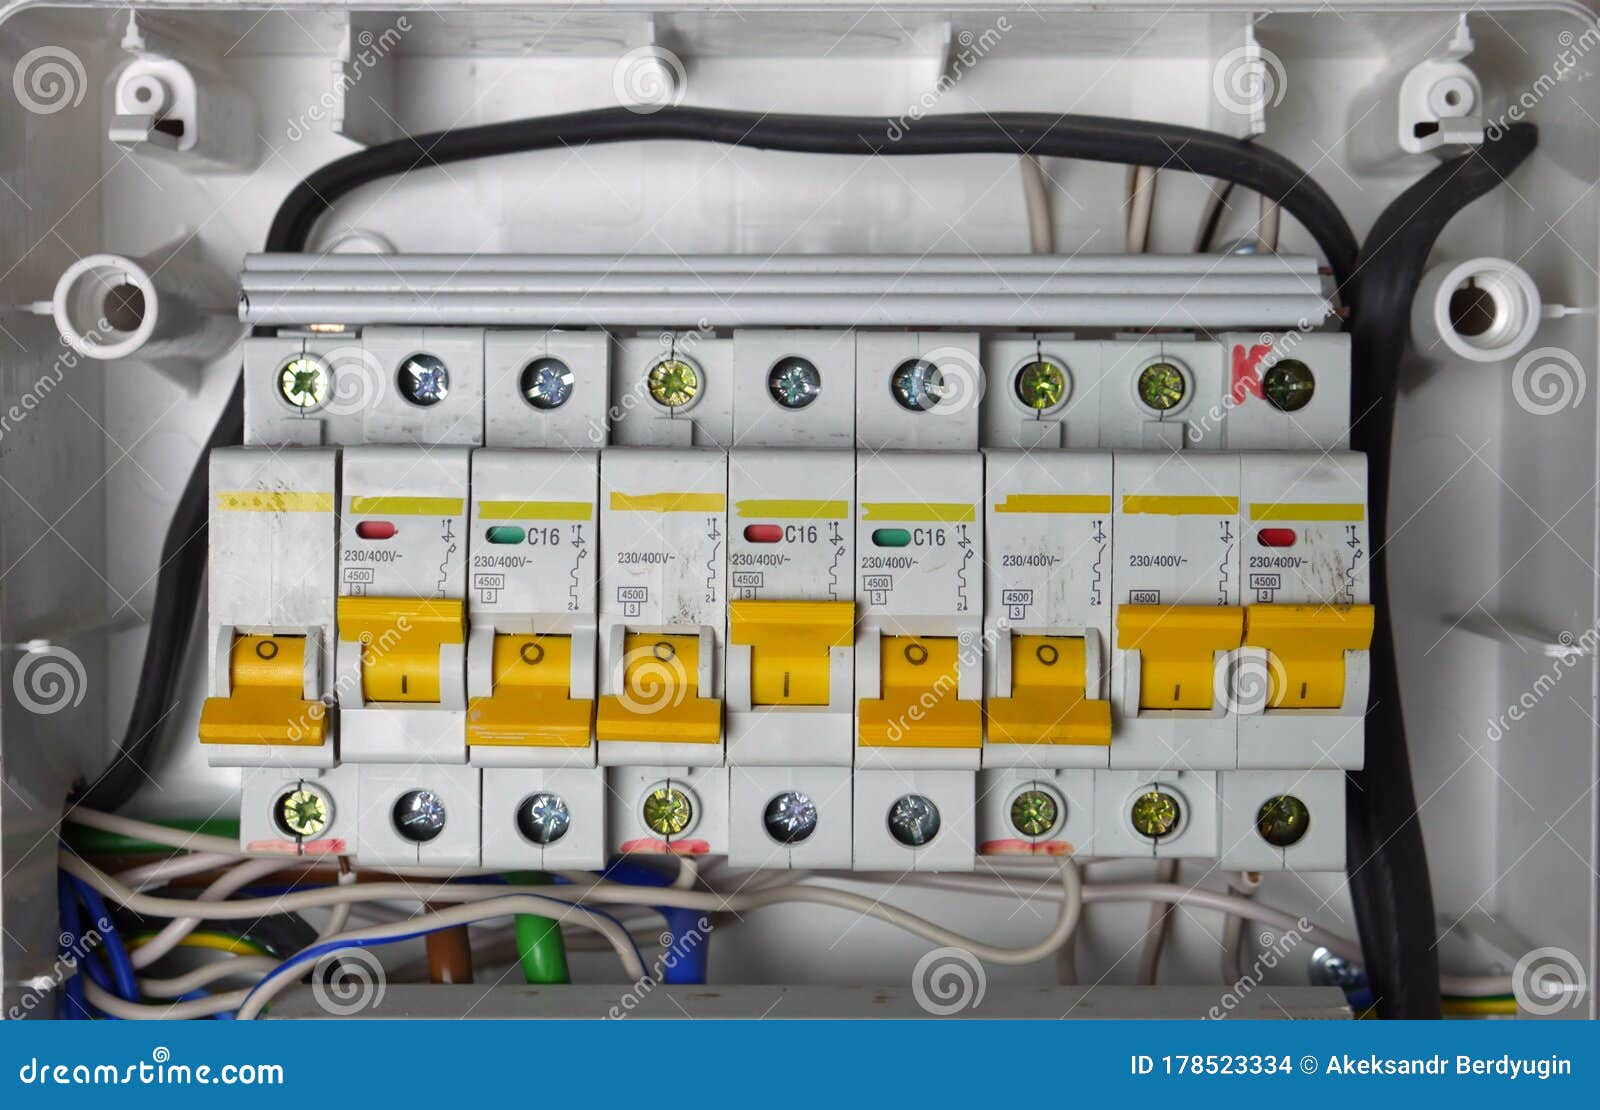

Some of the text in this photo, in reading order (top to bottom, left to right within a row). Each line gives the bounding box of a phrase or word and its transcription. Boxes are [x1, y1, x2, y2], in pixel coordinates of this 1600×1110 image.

[528, 527, 560, 545] C16
[785, 525, 817, 543] C16
[914, 528, 946, 546] C16
[348, 571, 370, 581] 4500
[737, 575, 759, 585] 4500
[478, 577, 501, 587] 4500
[867, 578, 889, 588] 4500
[1254, 577, 1277, 587] 4500
[622, 590, 644, 600] 4500
[1006, 593, 1029, 602] 4500
[1134, 593, 1156, 603] 4500
